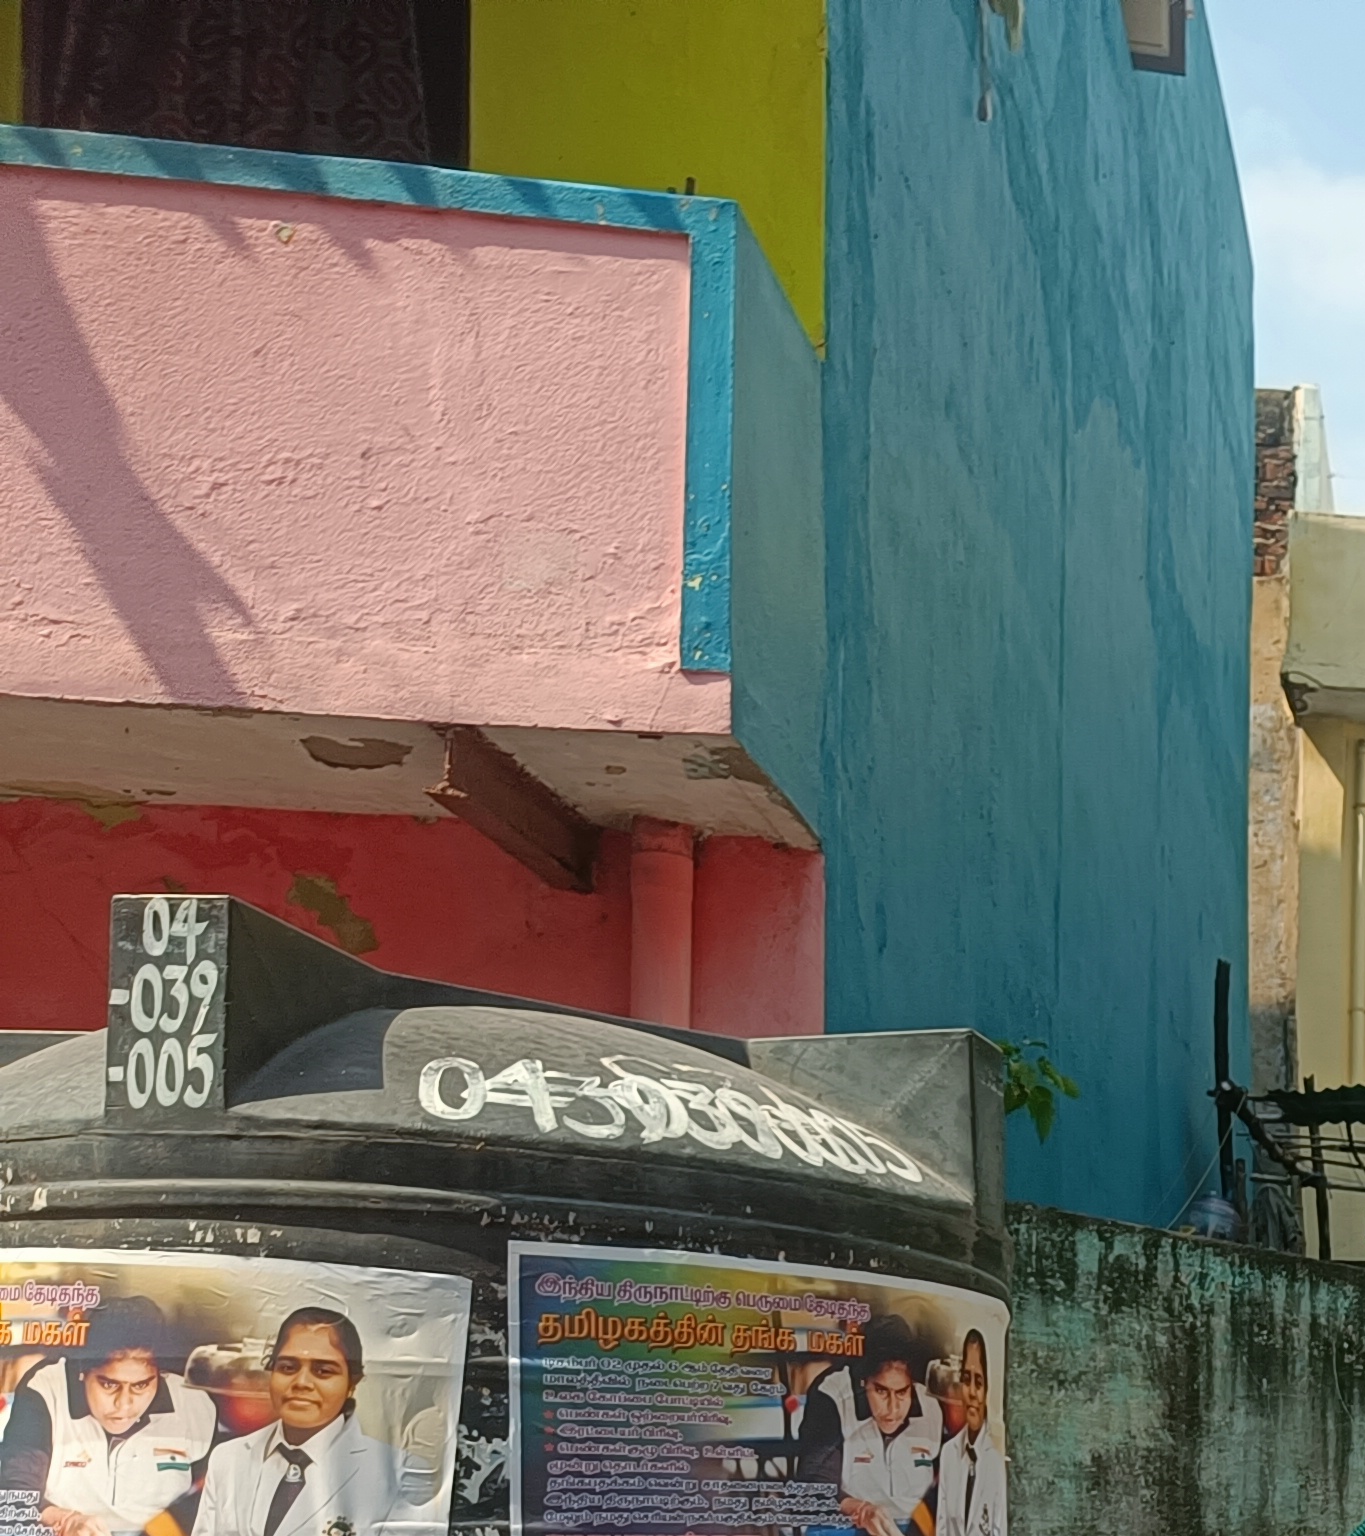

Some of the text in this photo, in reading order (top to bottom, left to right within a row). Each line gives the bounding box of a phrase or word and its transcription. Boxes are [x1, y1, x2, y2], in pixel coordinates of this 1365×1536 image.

[143, 898, 209, 965] 04
[109, 959, 218, 1036] -039
[108, 1033, 218, 1109] -005
[535, 1272, 613, 1301] இந்திய
[617, 1278, 732, 1309] திருநாட்டிற்கு
[735, 1289, 802, 1313] பெருமை
[22, 1313, 90, 1347] மகள்
[537, 1307, 866, 1358] தமிழகத்தின் தங்க மகள்
[600, 1359, 622, 1371] 02
[624, 1358, 666, 1375] முதல்
[667, 1360, 679, 1373] 6
